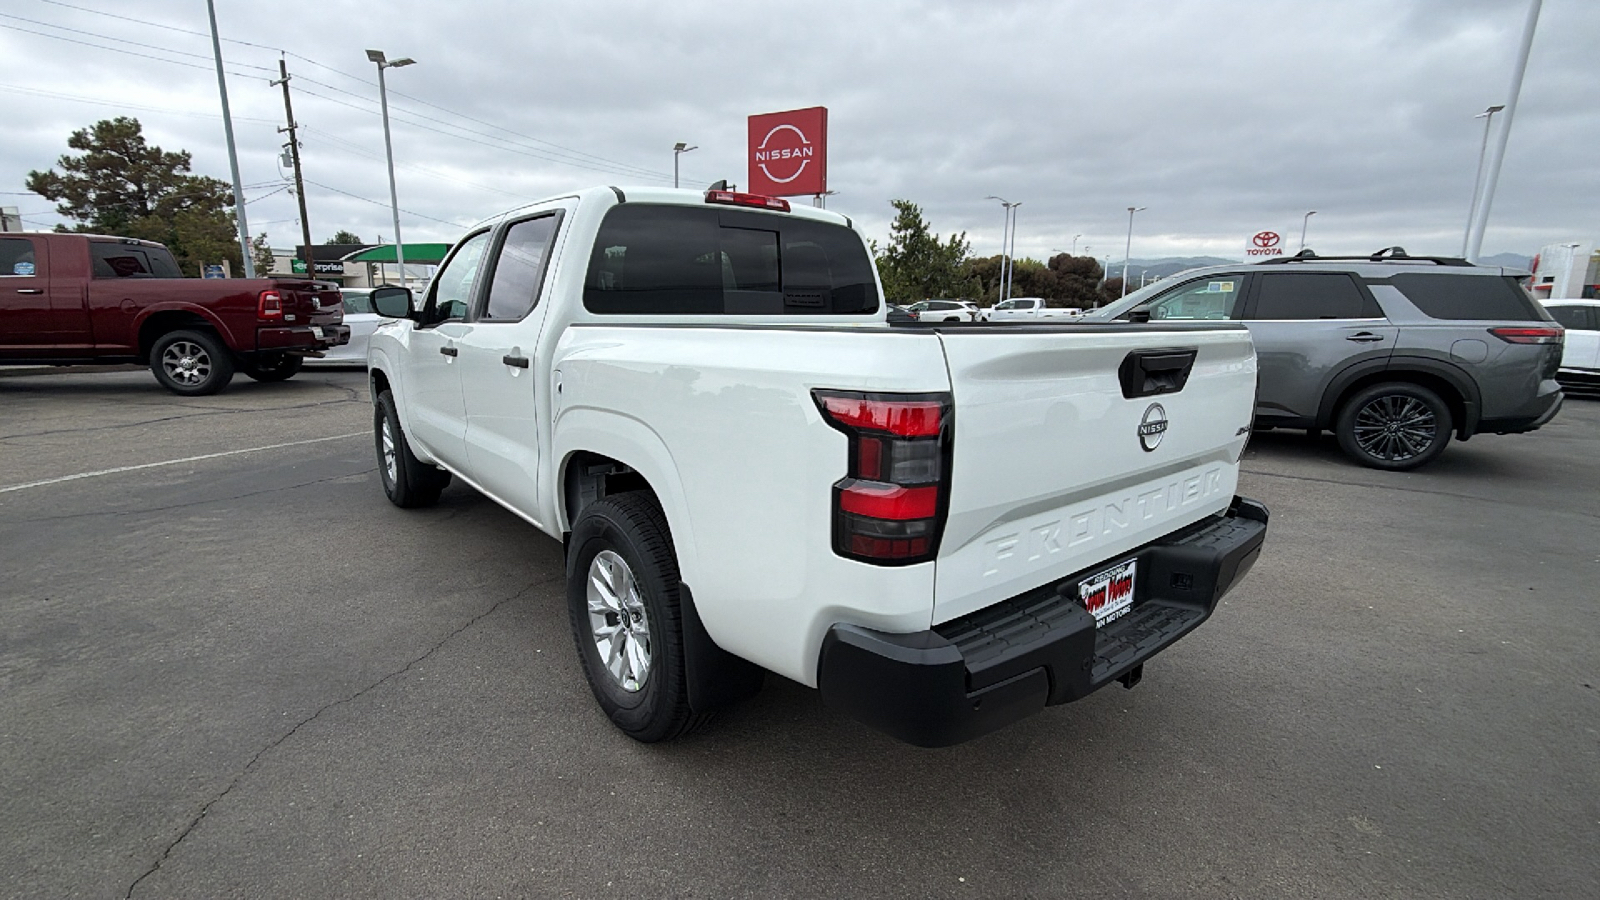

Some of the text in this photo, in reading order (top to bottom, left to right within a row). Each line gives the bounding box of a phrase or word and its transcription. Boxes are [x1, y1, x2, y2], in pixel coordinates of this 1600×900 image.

[756, 146, 813, 161] NISSAN
[1246, 248, 1282, 256] TOYOTA
[983, 467, 1221, 577] FRONTIER
[1094, 565, 1125, 583] REDDING
[1106, 605, 1131, 624] MOTORS
